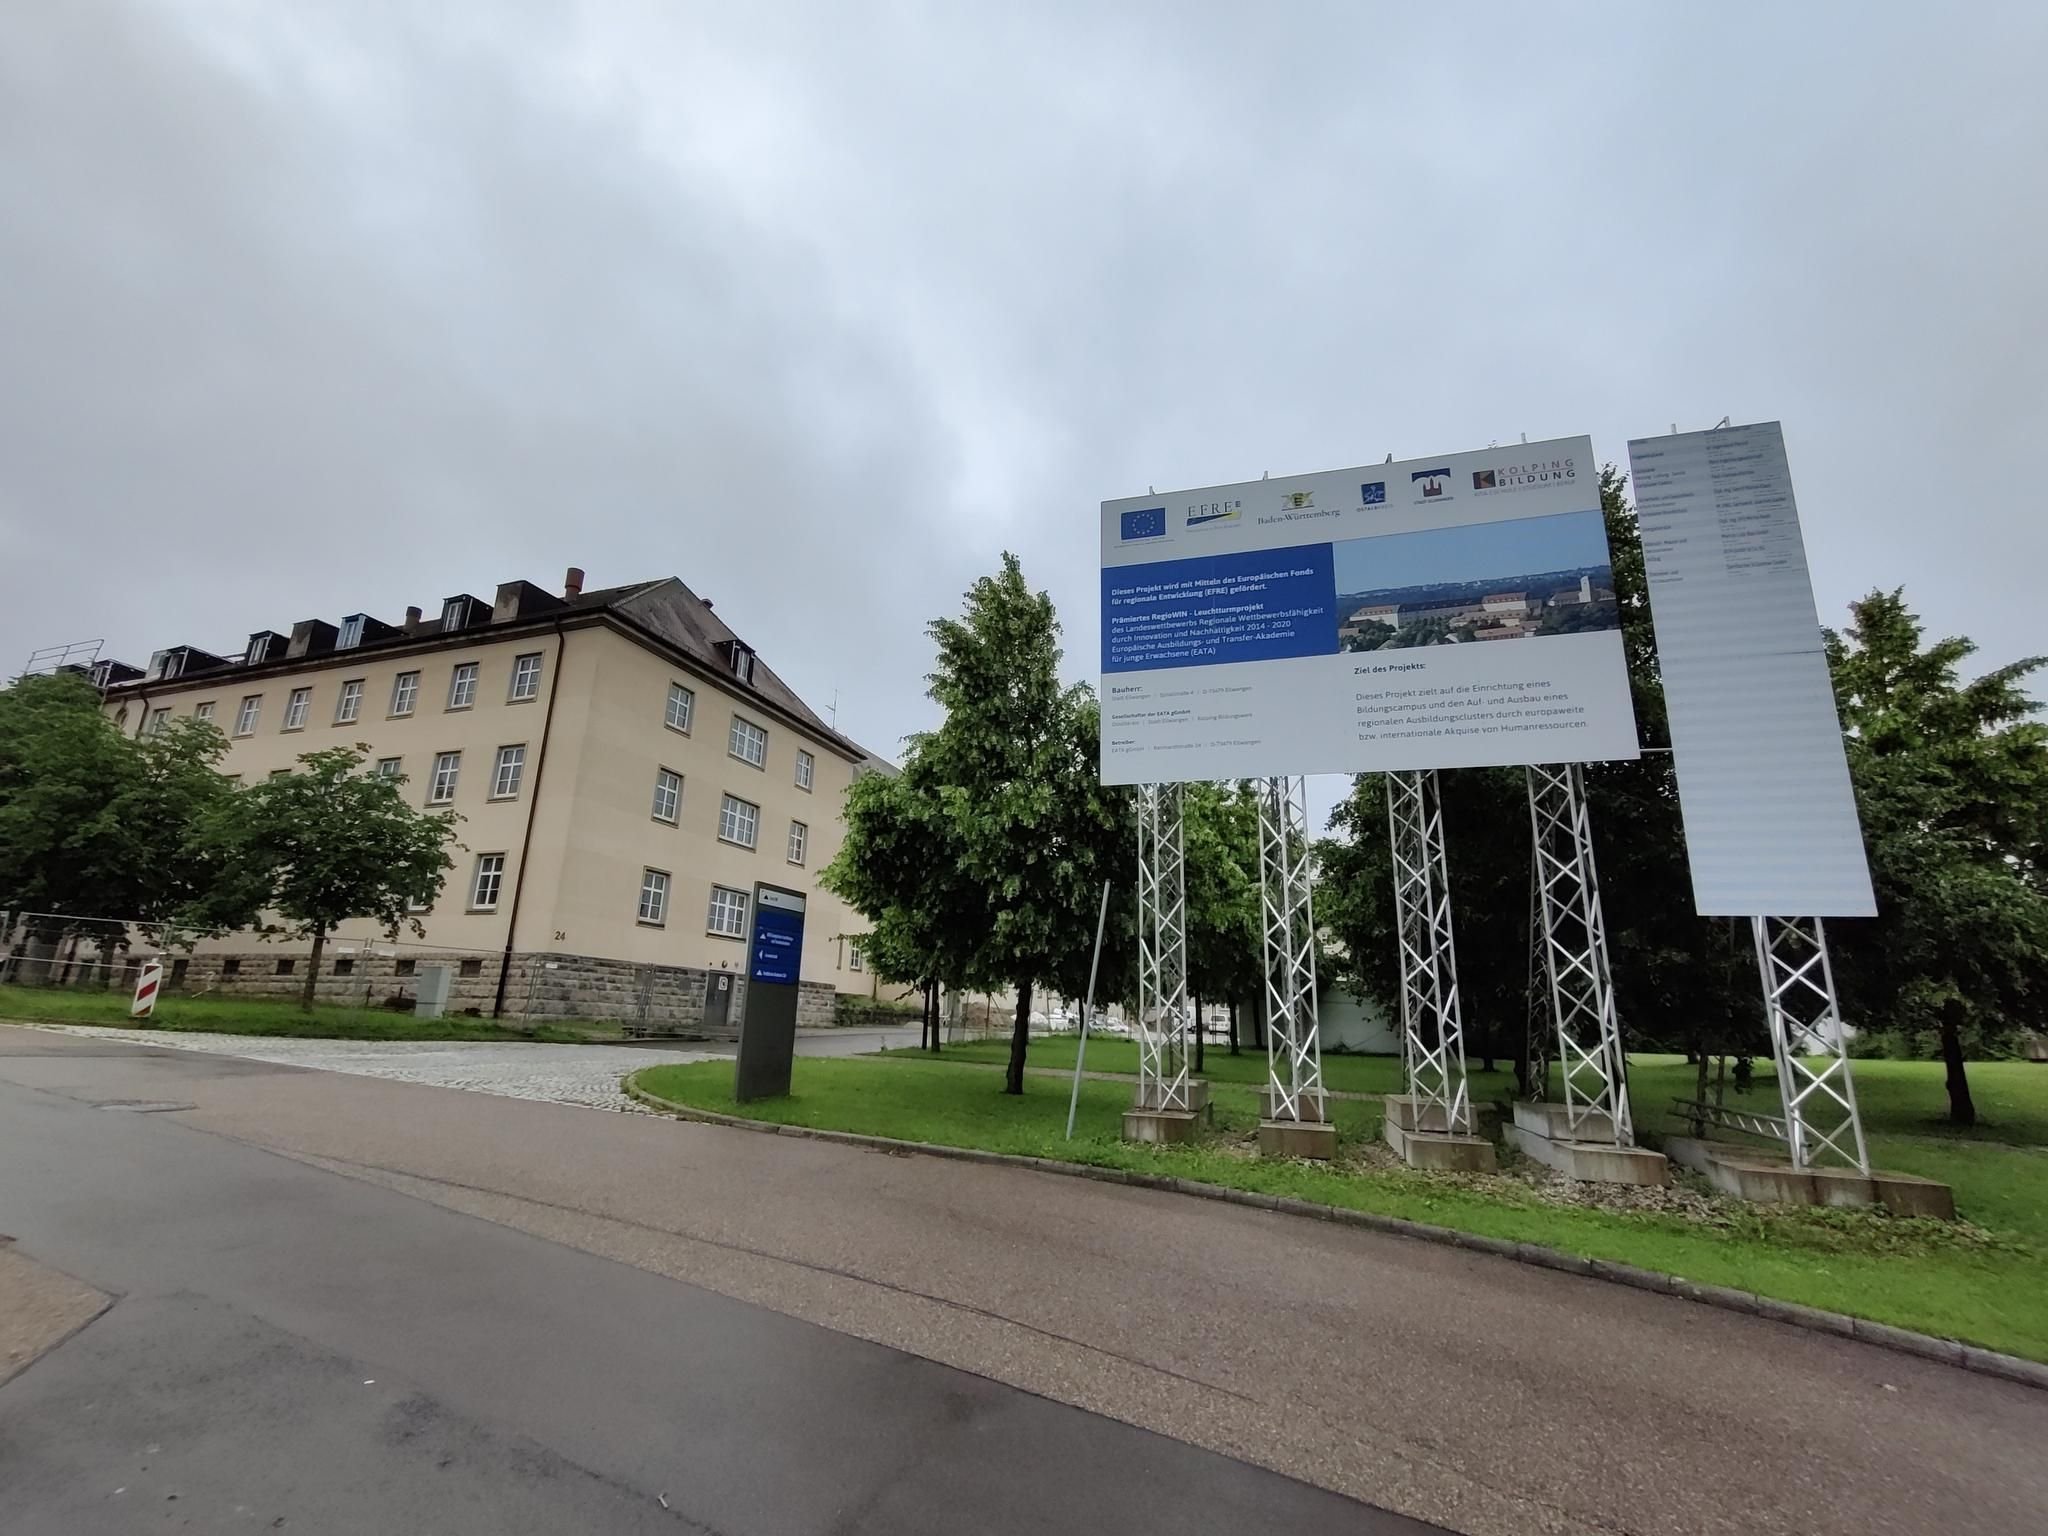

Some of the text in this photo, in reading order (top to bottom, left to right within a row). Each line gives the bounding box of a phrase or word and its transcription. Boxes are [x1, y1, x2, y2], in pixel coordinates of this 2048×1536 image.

[1497, 459, 1574, 476] KOLPING
[1499, 469, 1576, 486] BILDUNG
[1188, 502, 1233, 517] EFRE
[1257, 509, 1341, 525] Baden-Württemberg
[1112, 588, 1134, 596] Dieses
[1136, 585, 1161, 594] Projekt
[1195, 578, 1220, 586] Mitteln
[1237, 571, 1288, 583] Europäischen
[1290, 568, 1314, 576] Fonds
[1123, 596, 1157, 604] regionale
[1159, 590, 1203, 600] Entwicklung
[1204, 587, 1228, 597] (EFRE)
[1230, 583, 1267, 594] gefördert.
[1112, 615, 1150, 624] Prämiertes
[1152, 611, 1188, 621] RegioWIN
[1194, 603, 1264, 616] Leuchtturmprojekt
[1112, 607, 1324, 634] des Landeswettbewerbs Regionale Wettbewerbsfähigkeit
[1134, 632, 1172, 641] Innovation
[1190, 624, 1245, 636] Nachhaltigkeit
[1246, 623, 1265, 631] 2014
[1272, 620, 1291, 628] 2020
[1112, 643, 1156, 653] Europäische
[1157, 638, 1204, 649] Ausbildungs-
[1222, 630, 1295, 643] Transfer-Akademie
[1124, 654, 1144, 663] junge
[1145, 650, 1189, 660] Erwachsene
[1191, 647, 1216, 657] (EATA)
[1354, 666, 1370, 674] Ziel
[1389, 663, 1426, 672] Projekts:
[1112, 686, 1143, 694] Bauherr:
[1356, 692, 1383, 700] Dieses
[1385, 690, 1416, 699] Projekt
[1418, 688, 1437, 696] zielt
[1440, 686, 1454, 694] auf
[1472, 682, 1524, 692] Einrichtung
[1357, 693, 1568, 714] Bildungscampus und den Auf- und Ausbau eines
[1358, 706, 1584, 728] regionalen Ausbildungsclusters durch europaweite
[1380, 728, 1442, 739] internationale
[1445, 727, 1479, 736] Akquise
[1482, 725, 1498, 734] von
[555, 931, 566, 942] 24
